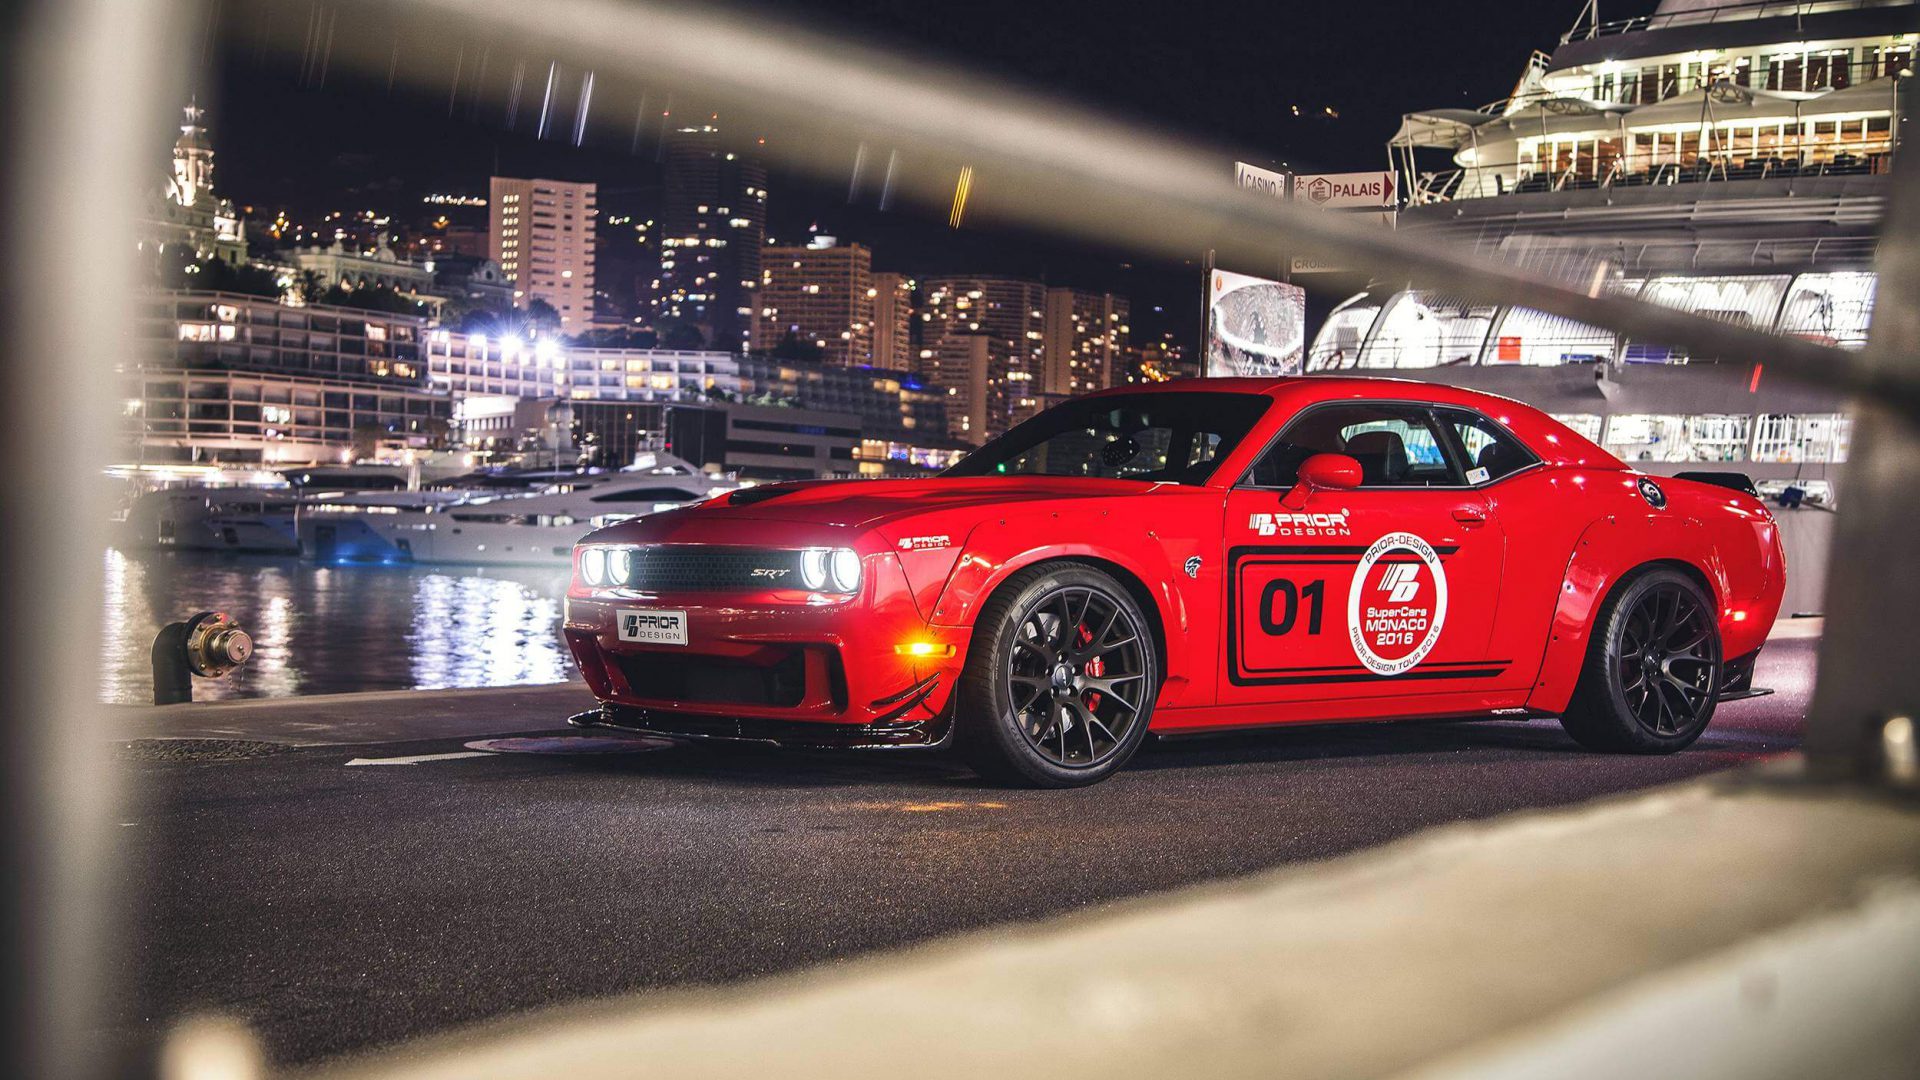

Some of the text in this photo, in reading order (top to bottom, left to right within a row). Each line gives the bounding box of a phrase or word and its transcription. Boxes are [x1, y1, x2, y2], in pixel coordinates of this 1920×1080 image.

[1245, 174, 1277, 197] CASINO
[1333, 182, 1381, 197] PALAIS
[1275, 513, 1347, 527] PRIOR
[1280, 528, 1351, 536] DESIGN
[1365, 534, 1436, 564] PRIOR-DESIGN
[751, 569, 791, 579] SRT
[1259, 578, 1325, 636] 01
[1366, 606, 1428, 620] SuperCars
[638, 615, 679, 630] PRIOR
[1365, 618, 1427, 632] MONACO
[639, 631, 680, 640] DESIGN
[1376, 632, 1414, 646] 2016
[1351, 625, 1440, 672] PRIOR-DESIGN TOUR 2016
